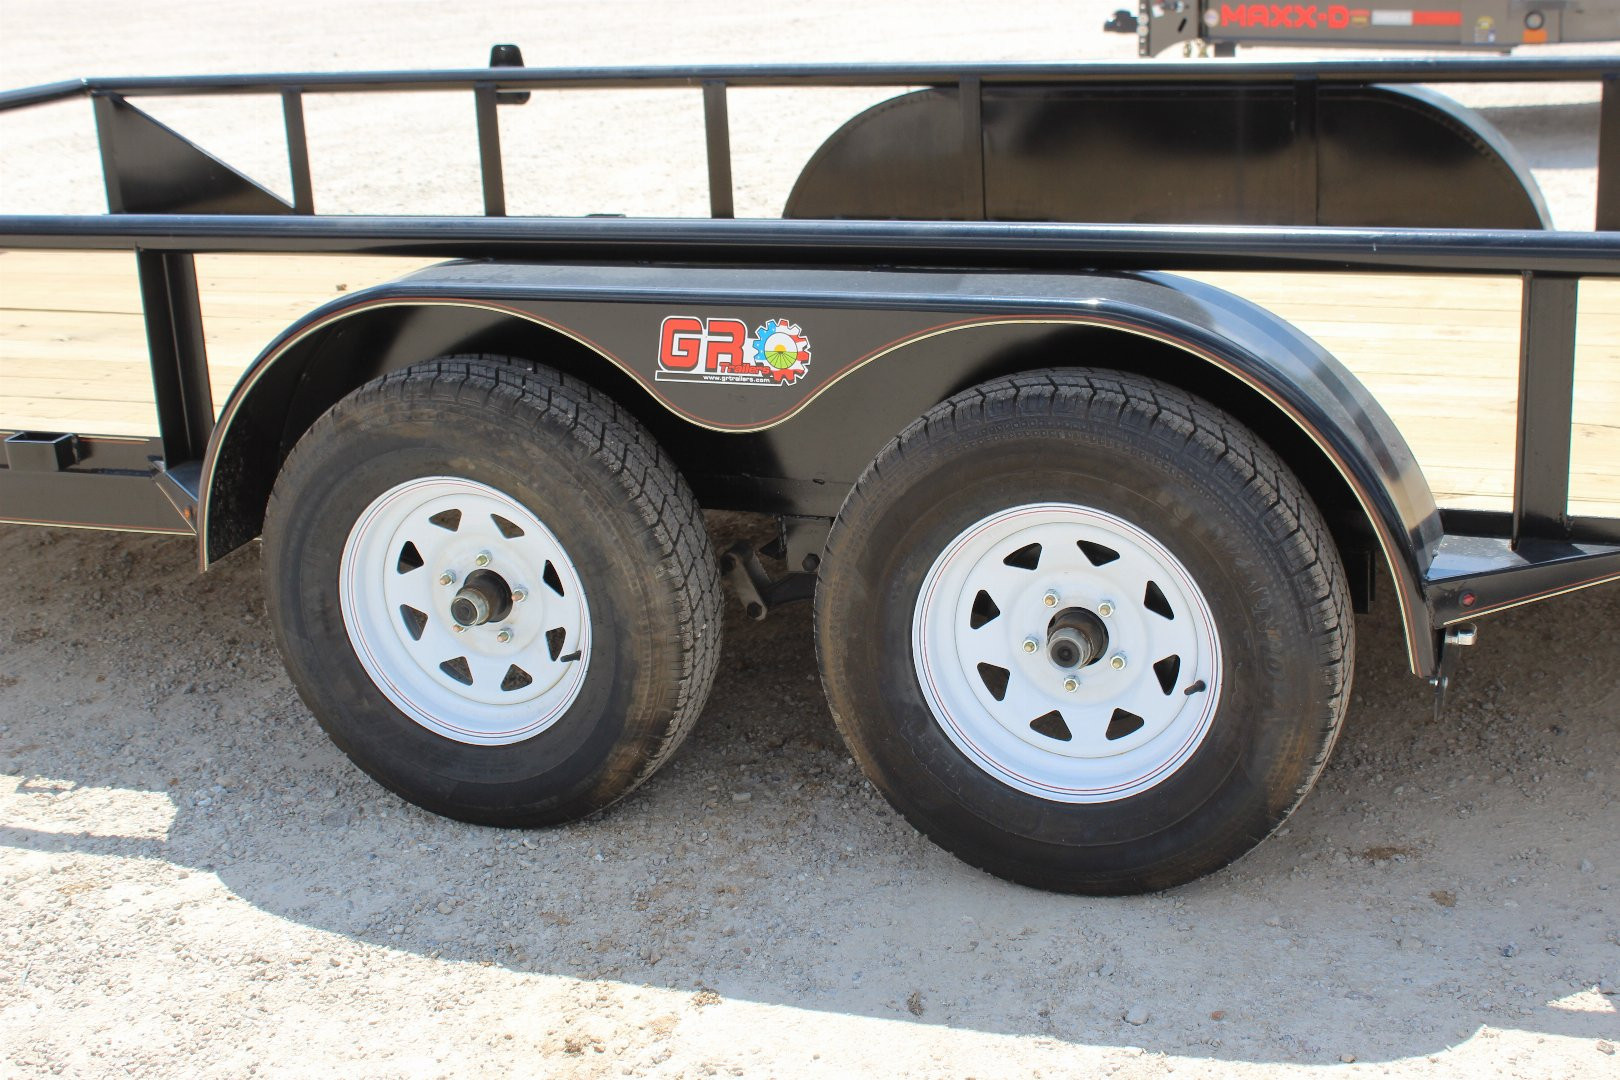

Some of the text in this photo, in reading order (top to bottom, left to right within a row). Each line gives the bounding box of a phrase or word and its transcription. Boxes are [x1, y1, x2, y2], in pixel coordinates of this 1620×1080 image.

[660, 318, 747, 372] GR
[719, 361, 771, 374] Trailers
[703, 375, 770, 383] www.grtrailers.com
